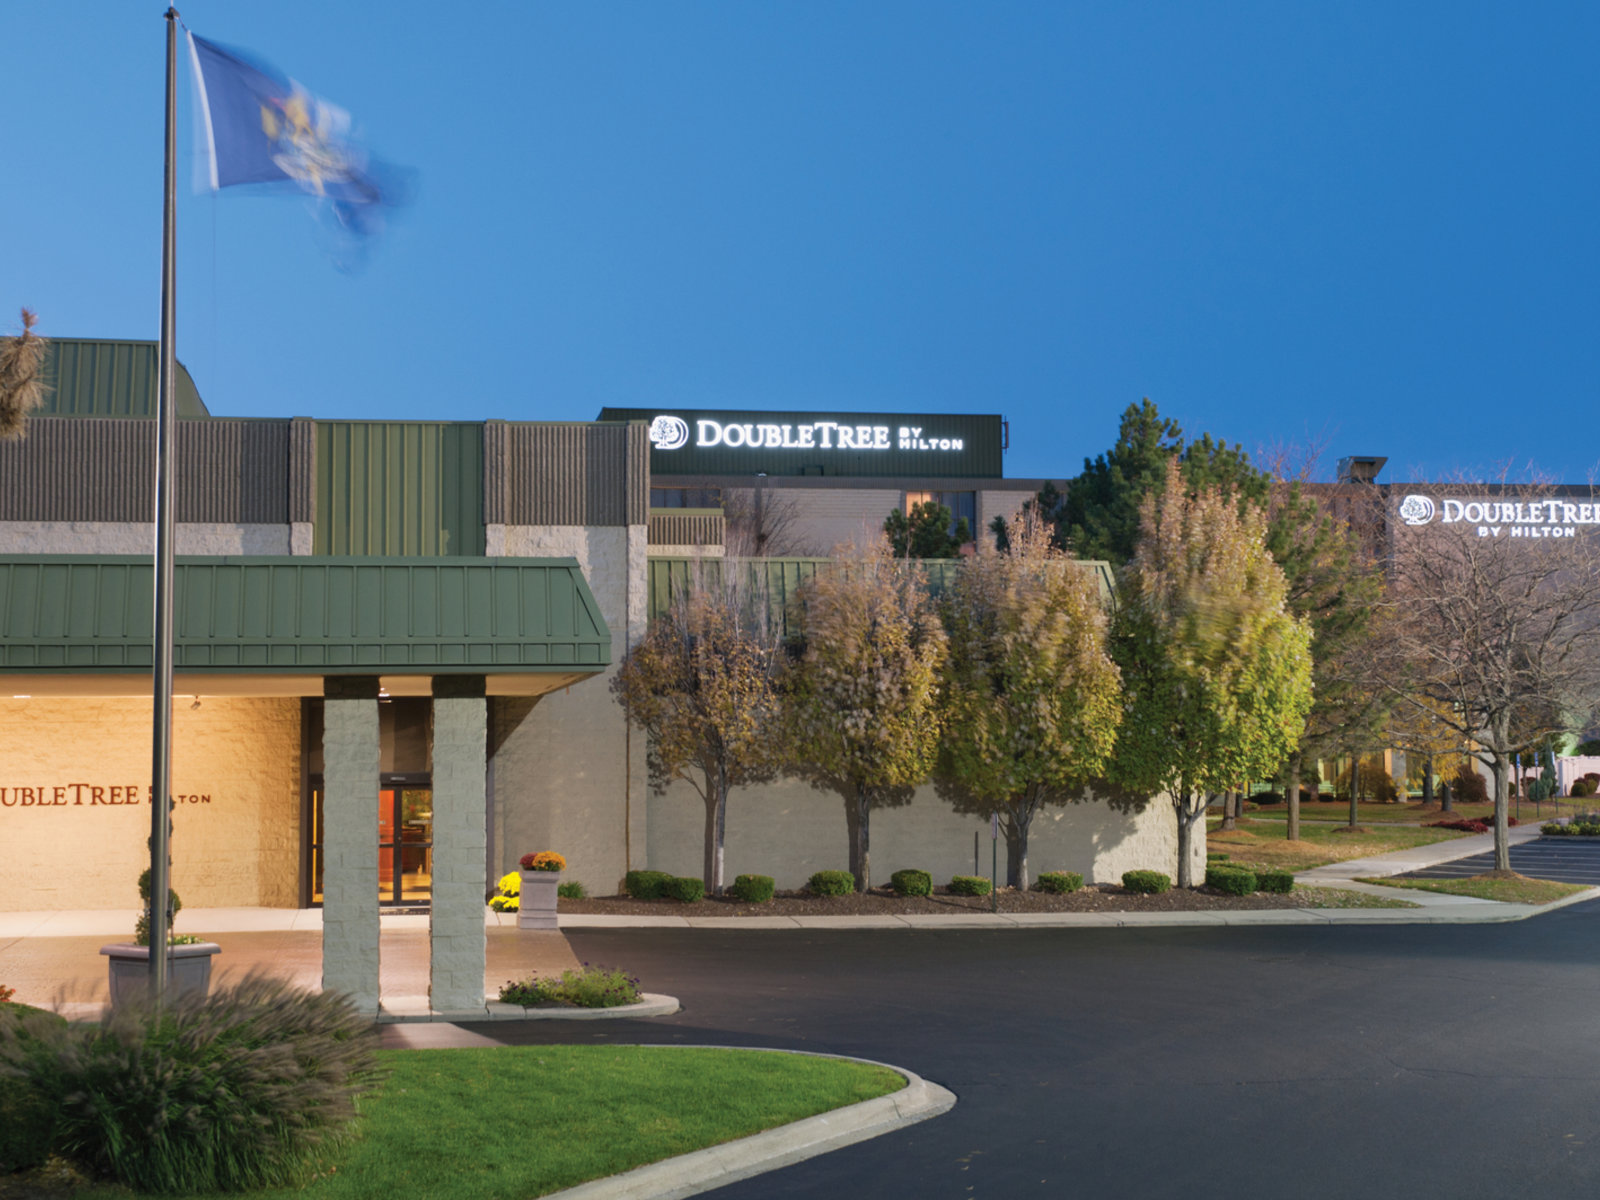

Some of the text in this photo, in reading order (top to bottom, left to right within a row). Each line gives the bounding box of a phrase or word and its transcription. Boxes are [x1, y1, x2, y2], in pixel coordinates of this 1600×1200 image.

[696, 420, 891, 449] DOUBLETREE
[899, 427, 922, 438] BY
[899, 439, 963, 450] HILTON
[1478, 527, 1575, 537] BY HILTON
